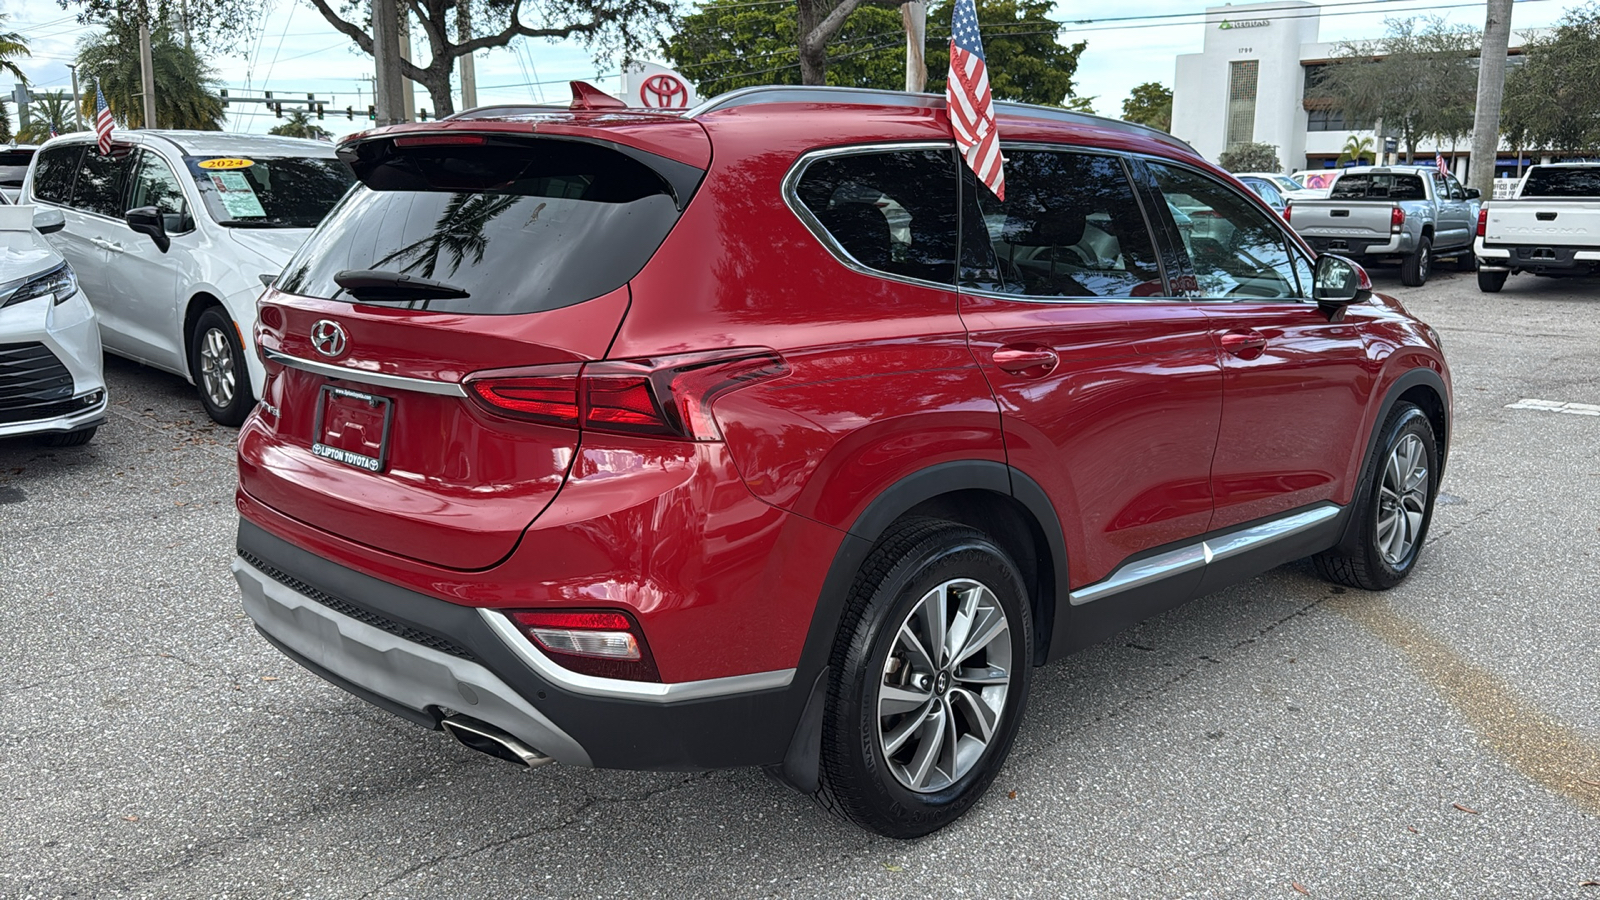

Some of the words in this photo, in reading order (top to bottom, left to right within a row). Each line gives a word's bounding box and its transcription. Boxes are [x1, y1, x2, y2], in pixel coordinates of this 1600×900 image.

[1231, 20, 1270, 29] REGIONS
[208, 159, 244, 168] 2024
[1505, 226, 1588, 234] TACOMA
[321, 446, 343, 461] LIPTON
[345, 452, 370, 468] TOYOTA
